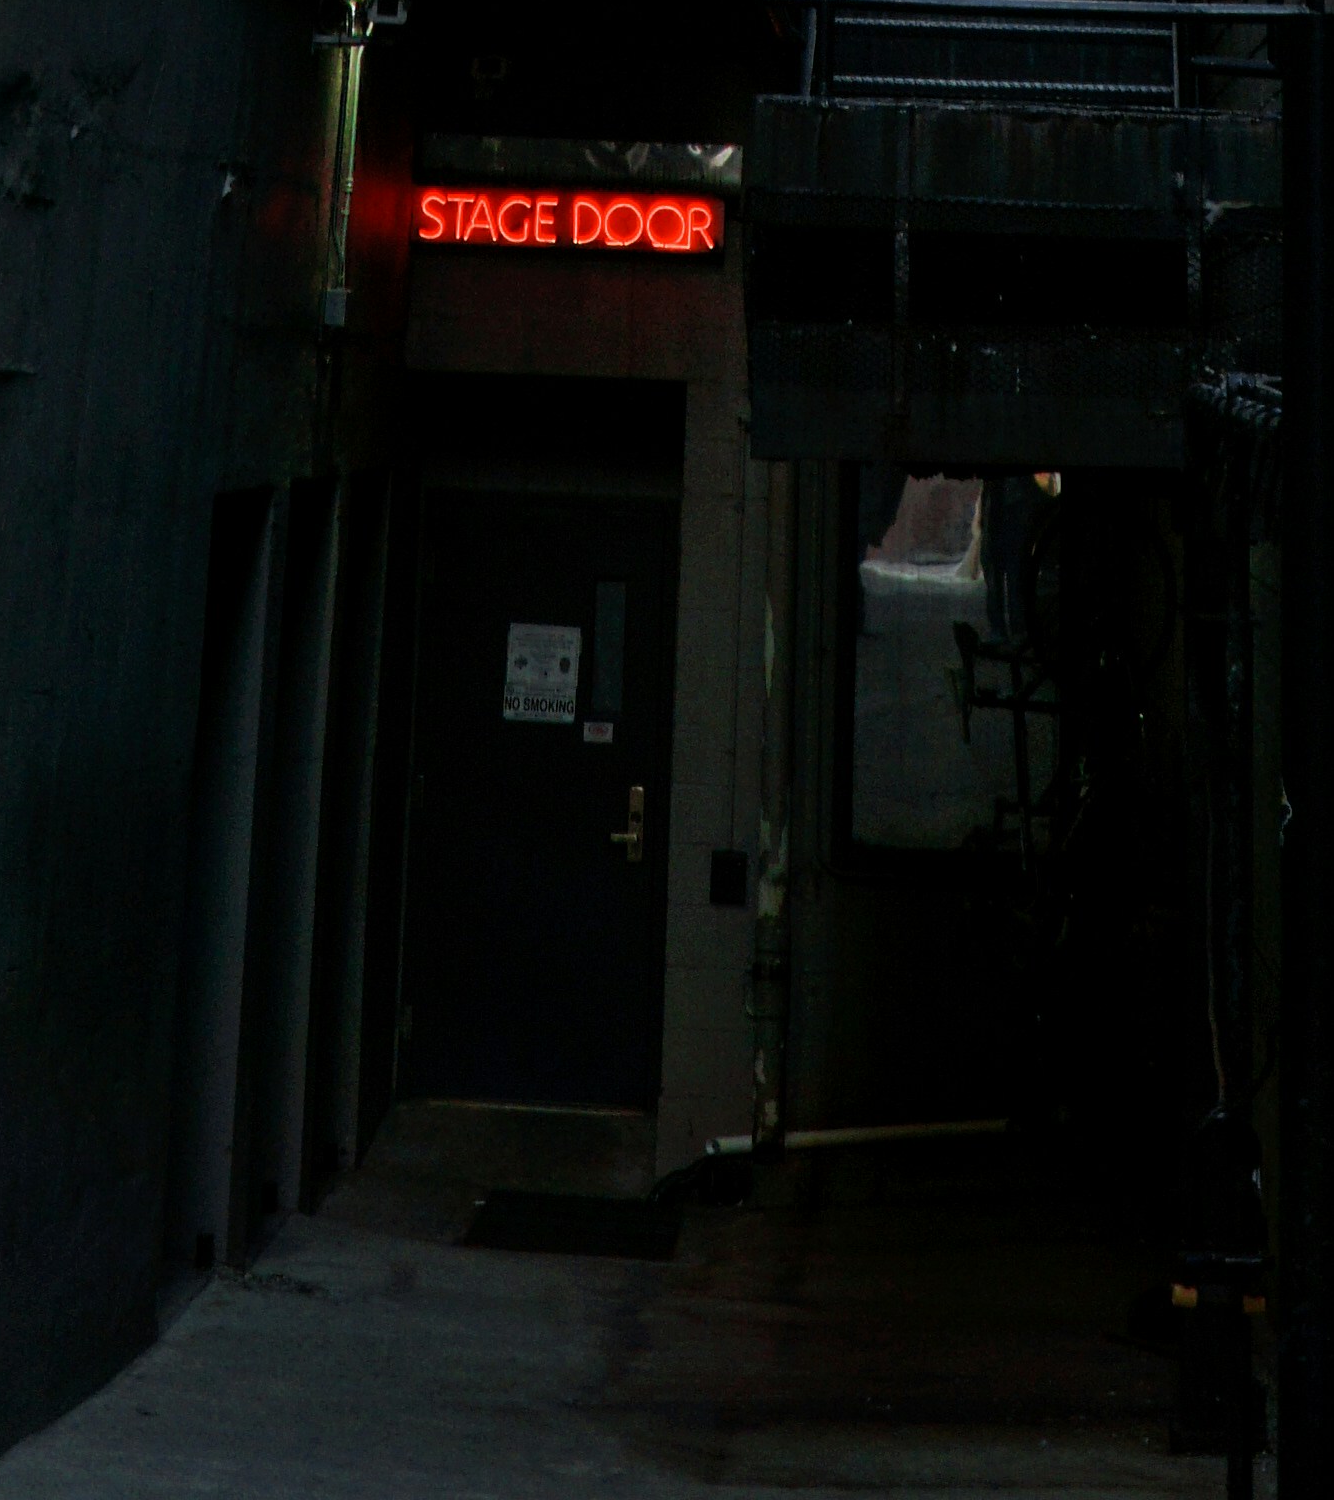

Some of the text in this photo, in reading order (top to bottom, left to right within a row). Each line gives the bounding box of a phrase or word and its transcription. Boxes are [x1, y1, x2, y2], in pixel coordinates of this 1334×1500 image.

[418, 193, 715, 251] STAGE DOOR
[504, 696, 575, 713] NO SMOKING
